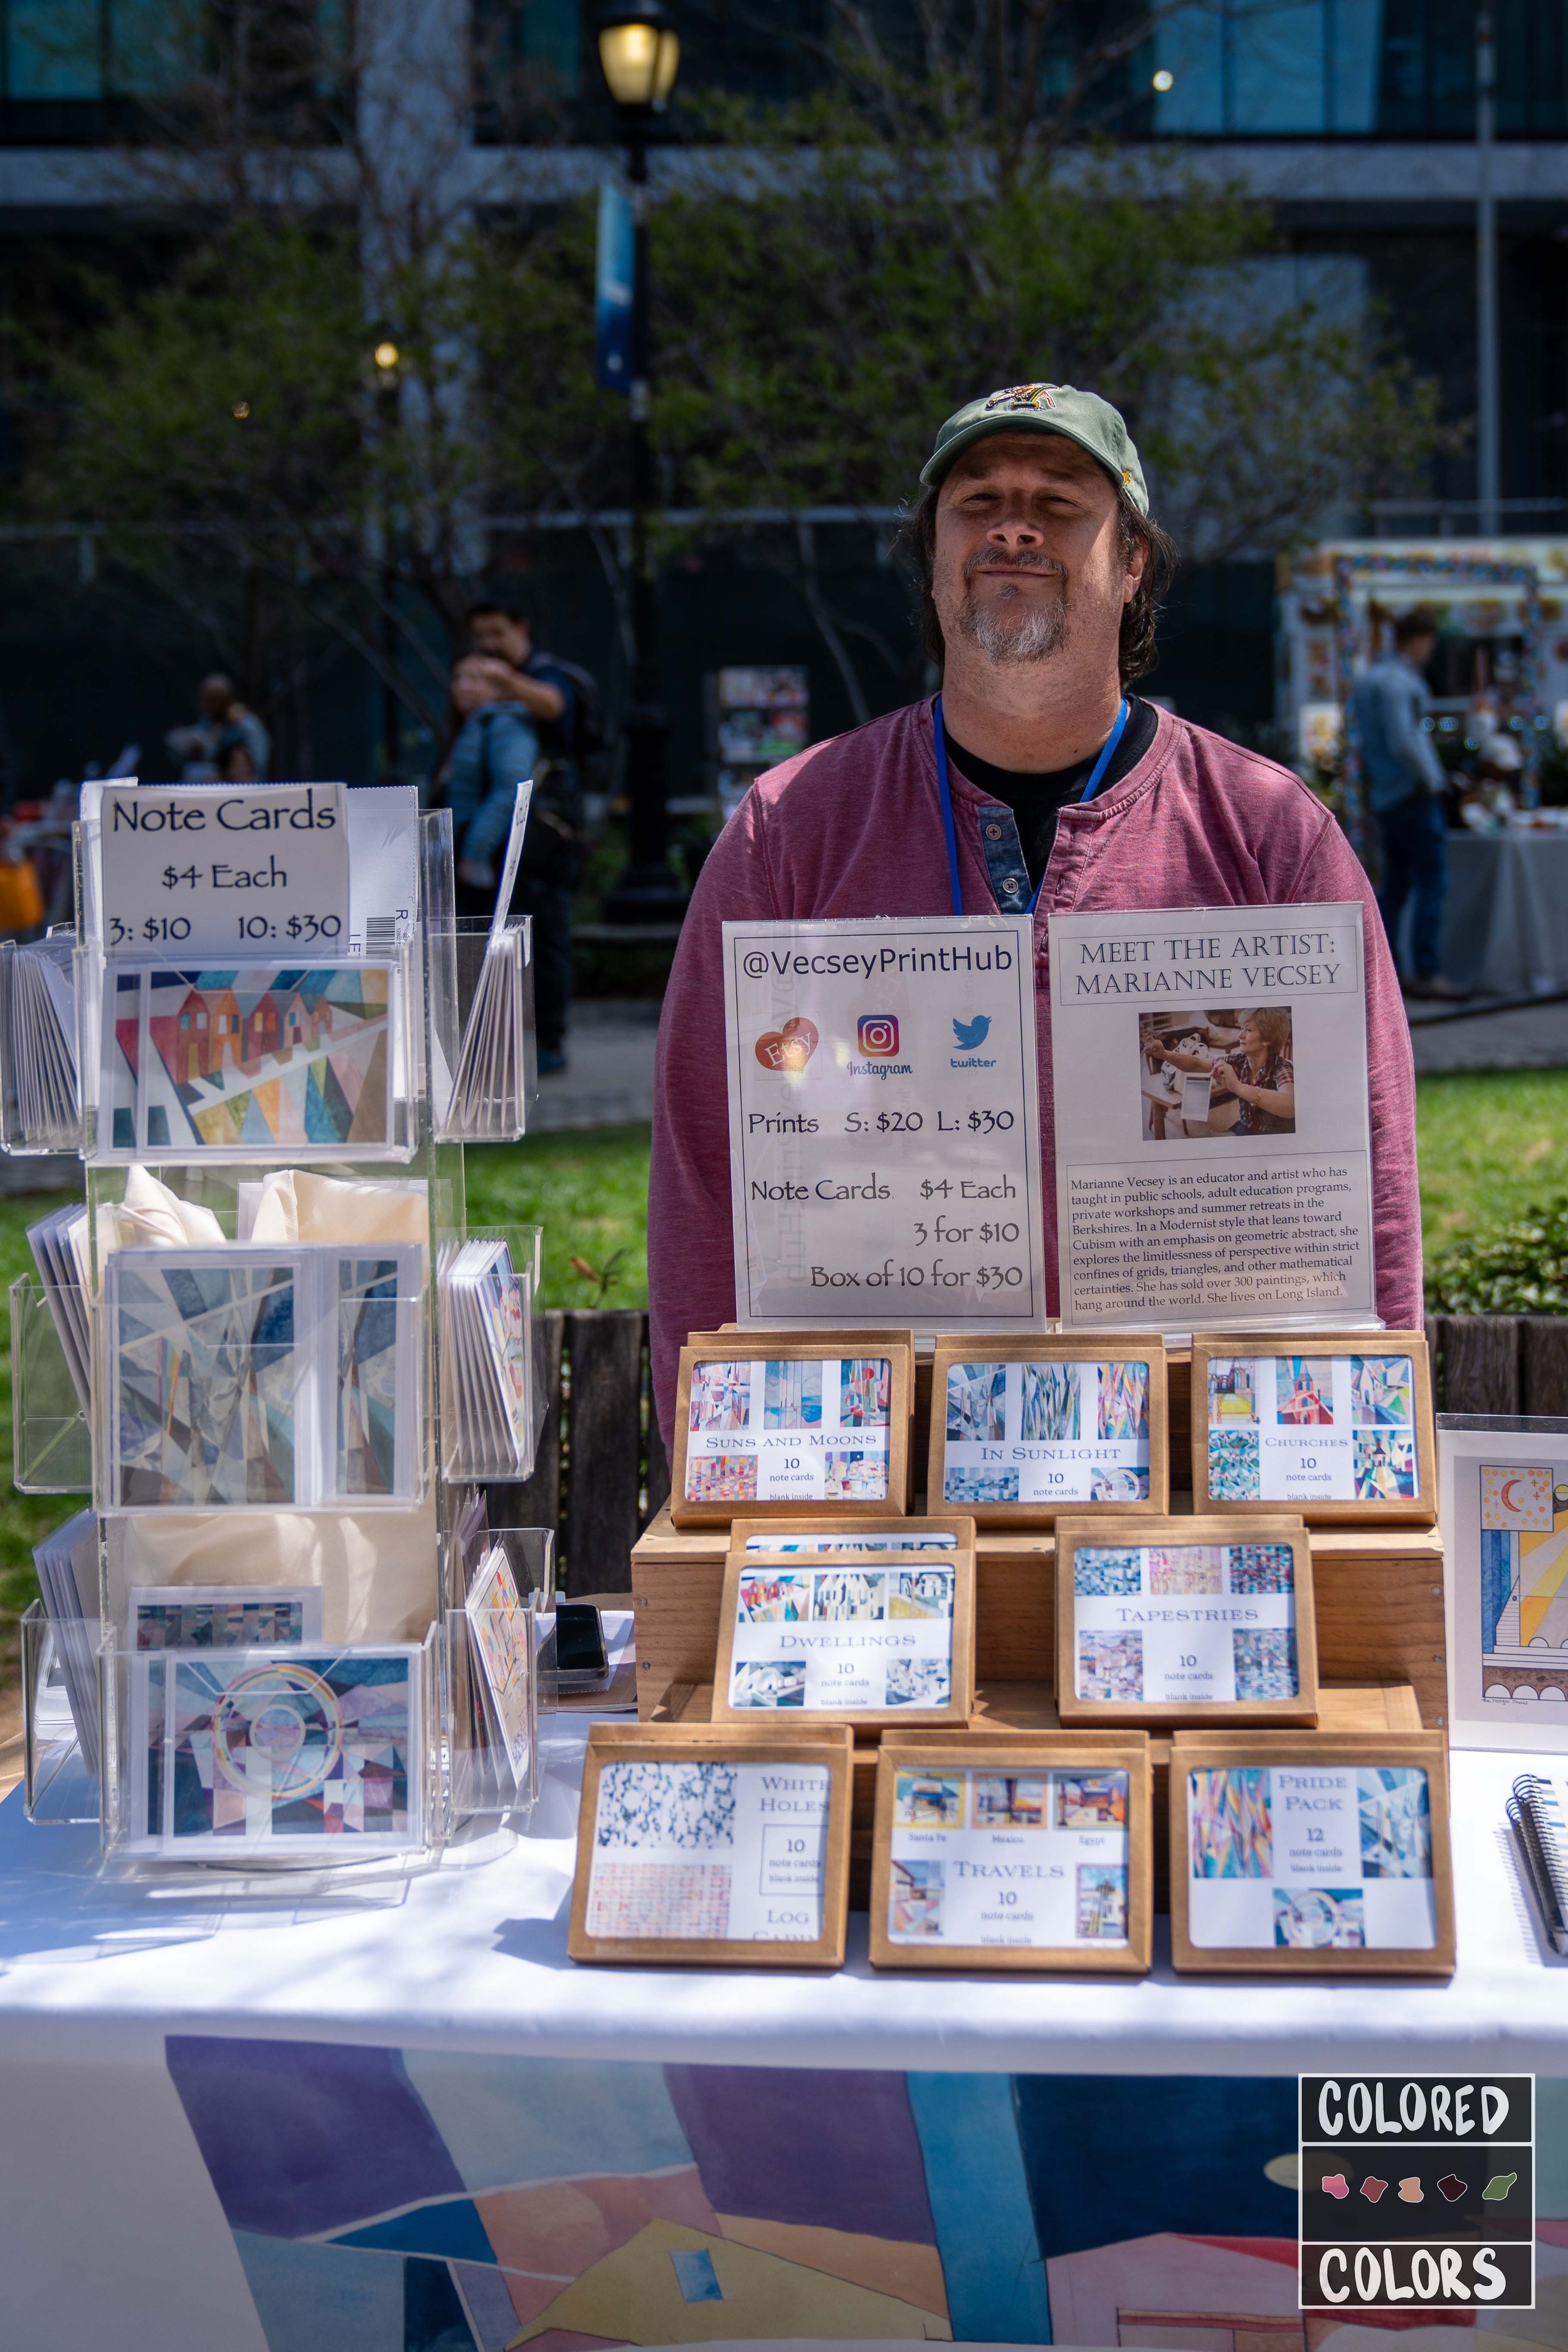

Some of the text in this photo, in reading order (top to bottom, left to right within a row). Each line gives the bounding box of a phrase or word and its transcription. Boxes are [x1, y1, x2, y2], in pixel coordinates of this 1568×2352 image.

[113, 789, 337, 832] Note Cards
[162, 856, 287, 889] $4 Each
[109, 916, 191, 946] 3: $10
[238, 914, 342, 941] 10: $30
[1080, 933, 1335, 964] MEET THE ARTIST:
[743, 945, 1012, 980] @VecseyPrintHub
[1075, 963, 1342, 995] MARIANNE VECSEY
[764, 1032, 812, 1067] Etsy
[847, 1061, 913, 1080] Instagram
[950, 1057, 997, 1069] twitter
[749, 1110, 1014, 1135] Prints S: $20 L: $30
[751, 1173, 1016, 1201] Note Cards $4 Each
[1071, 1179, 1124, 1190] Marianne
[1126, 1177, 1165, 1190] Vecsey
[1168, 1175, 1177, 1185] is
[1196, 1171, 1245, 1183] educator
[1247, 1170, 1268, 1180] and
[1271, 1169, 1300, 1179] artist
[1302, 1167, 1326, 1177] who
[1329, 1167, 1348, 1176] has
[1071, 1183, 1352, 1208] taught in public schools, adult education programs,
[1072, 1197, 1324, 1223] private workshops and summer retreats in the
[913, 1215, 1020, 1246] 3 for $10
[1073, 1222, 1133, 1235] Berkshires.
[1136, 1222, 1147, 1232] In
[1159, 1217, 1217, 1231] Modernist
[1219, 1216, 1245, 1231] style
[1248, 1215, 1269, 1226] that
[1272, 1214, 1300, 1224] leans
[1303, 1211, 1342, 1222] toward
[1073, 1238, 1116, 1250] Cubism
[1119, 1237, 1144, 1248] with
[1163, 1232, 1216, 1248] emphasis
[1235, 1230, 1289, 1244] geometric
[1291, 1226, 1337, 1240] abstract,
[1340, 1225, 1359, 1236] she
[1073, 1241, 1360, 1268] explores the limitlessness of perspective within strict
[811, 1259, 1022, 1290] Box of 10 for $30
[1073, 1256, 1353, 1280] confines of grids, triangles, and other mathematical
[1074, 1271, 1347, 1295] certainties. She has sold over 300 paintings, which
[1074, 1300, 1103, 1313] hang
[1105, 1296, 1145, 1308] around
[1148, 1295, 1166, 1306] the
[1168, 1293, 1204, 1305] world.
[1207, 1291, 1227, 1303] She
[1230, 1291, 1256, 1301] lives
[1275, 1289, 1303, 1302] Long
[1306, 1286, 1343, 1297] Island.
[784, 1458, 800, 1469] 10
[1300, 1458, 1316, 1468] 10
[790, 1473, 813, 1481] cards
[1048, 1473, 1064, 1484] 10
[1308, 1473, 1332, 1481] cards
[1054, 1487, 1078, 1495] cards
[837, 1663, 854, 1674] 10
[1179, 1655, 1197, 1666] 10
[844, 1678, 869, 1686] cards
[1189, 1671, 1213, 1680] cards
[786, 1840, 805, 1852] 10
[1306, 1828, 1325, 1841] 12
[1289, 1848, 1343, 1857] note cards
[999, 1892, 1017, 1905] 10
